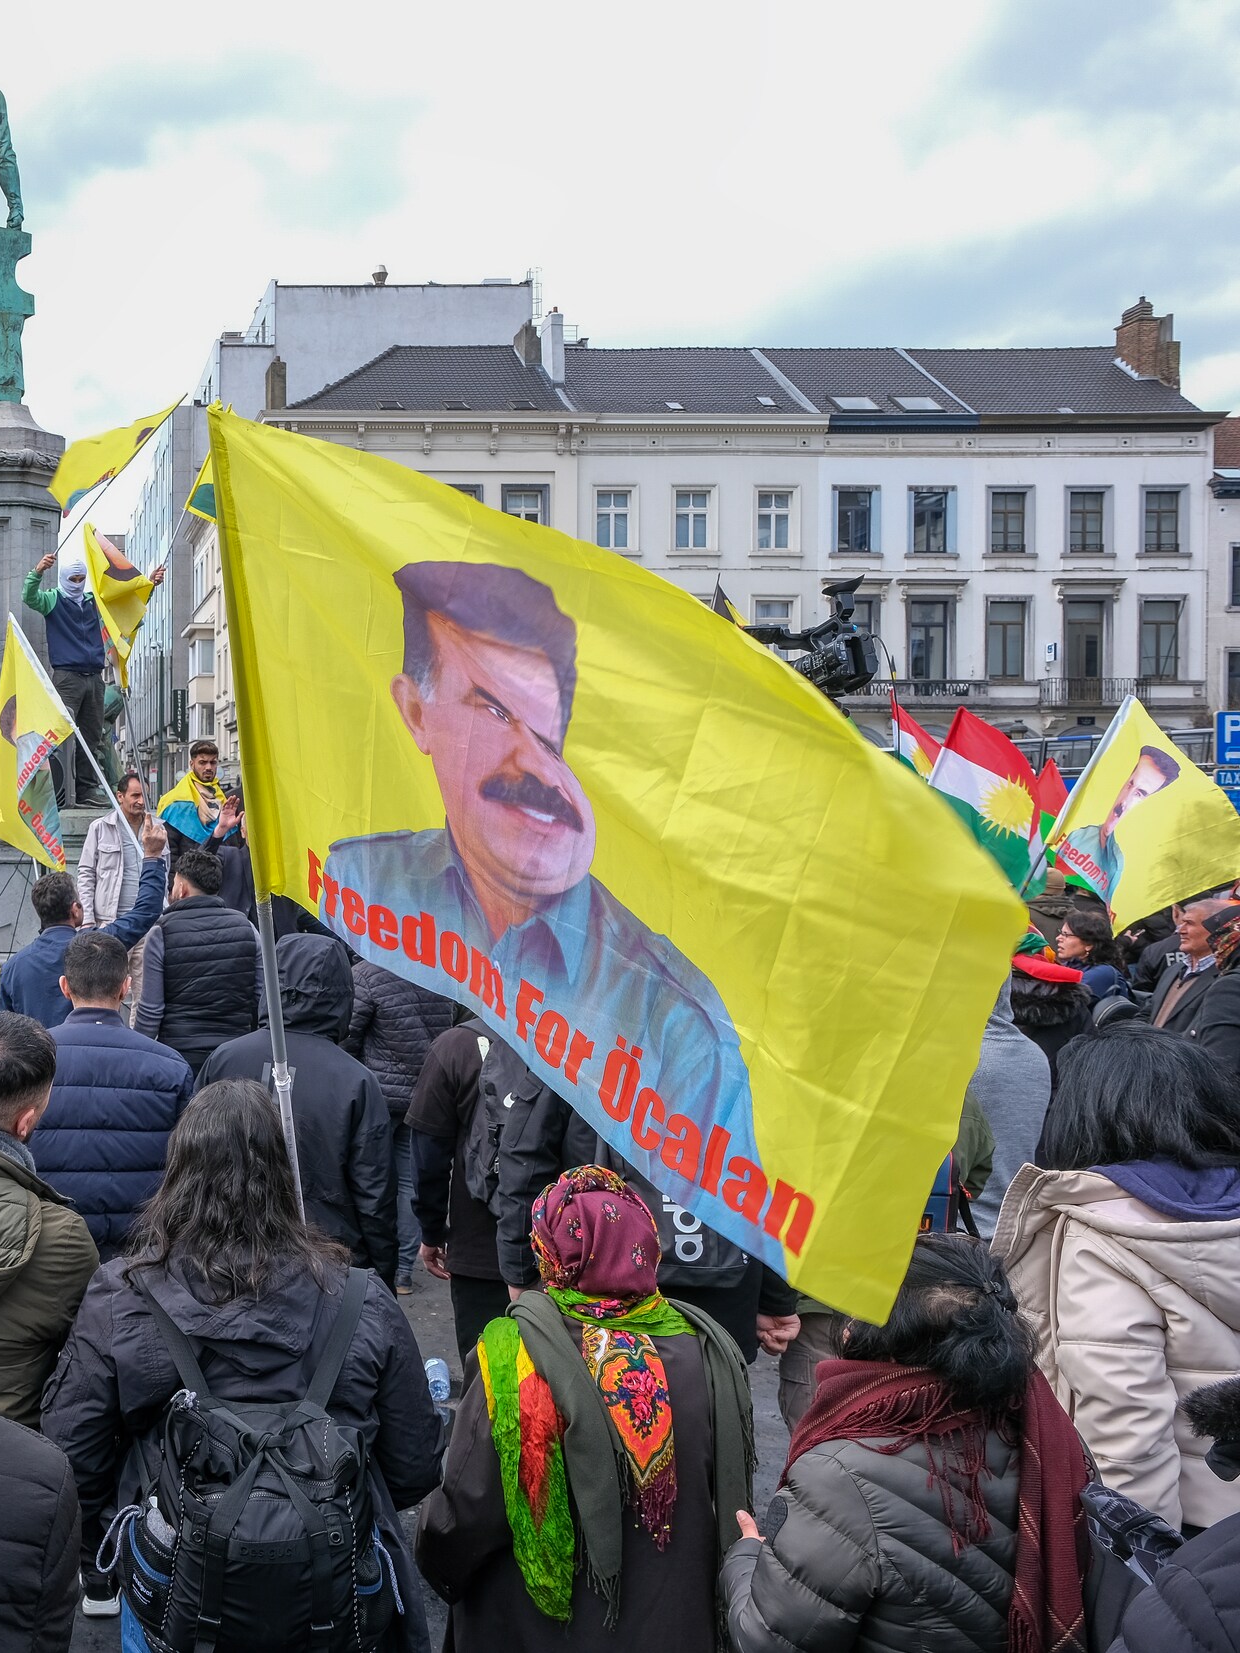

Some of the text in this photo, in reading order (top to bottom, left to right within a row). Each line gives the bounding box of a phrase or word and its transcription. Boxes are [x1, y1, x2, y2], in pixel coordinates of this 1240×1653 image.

[1054, 833, 1101, 880] Freedom
[307, 848, 816, 1258] Freedom For Öcalan
